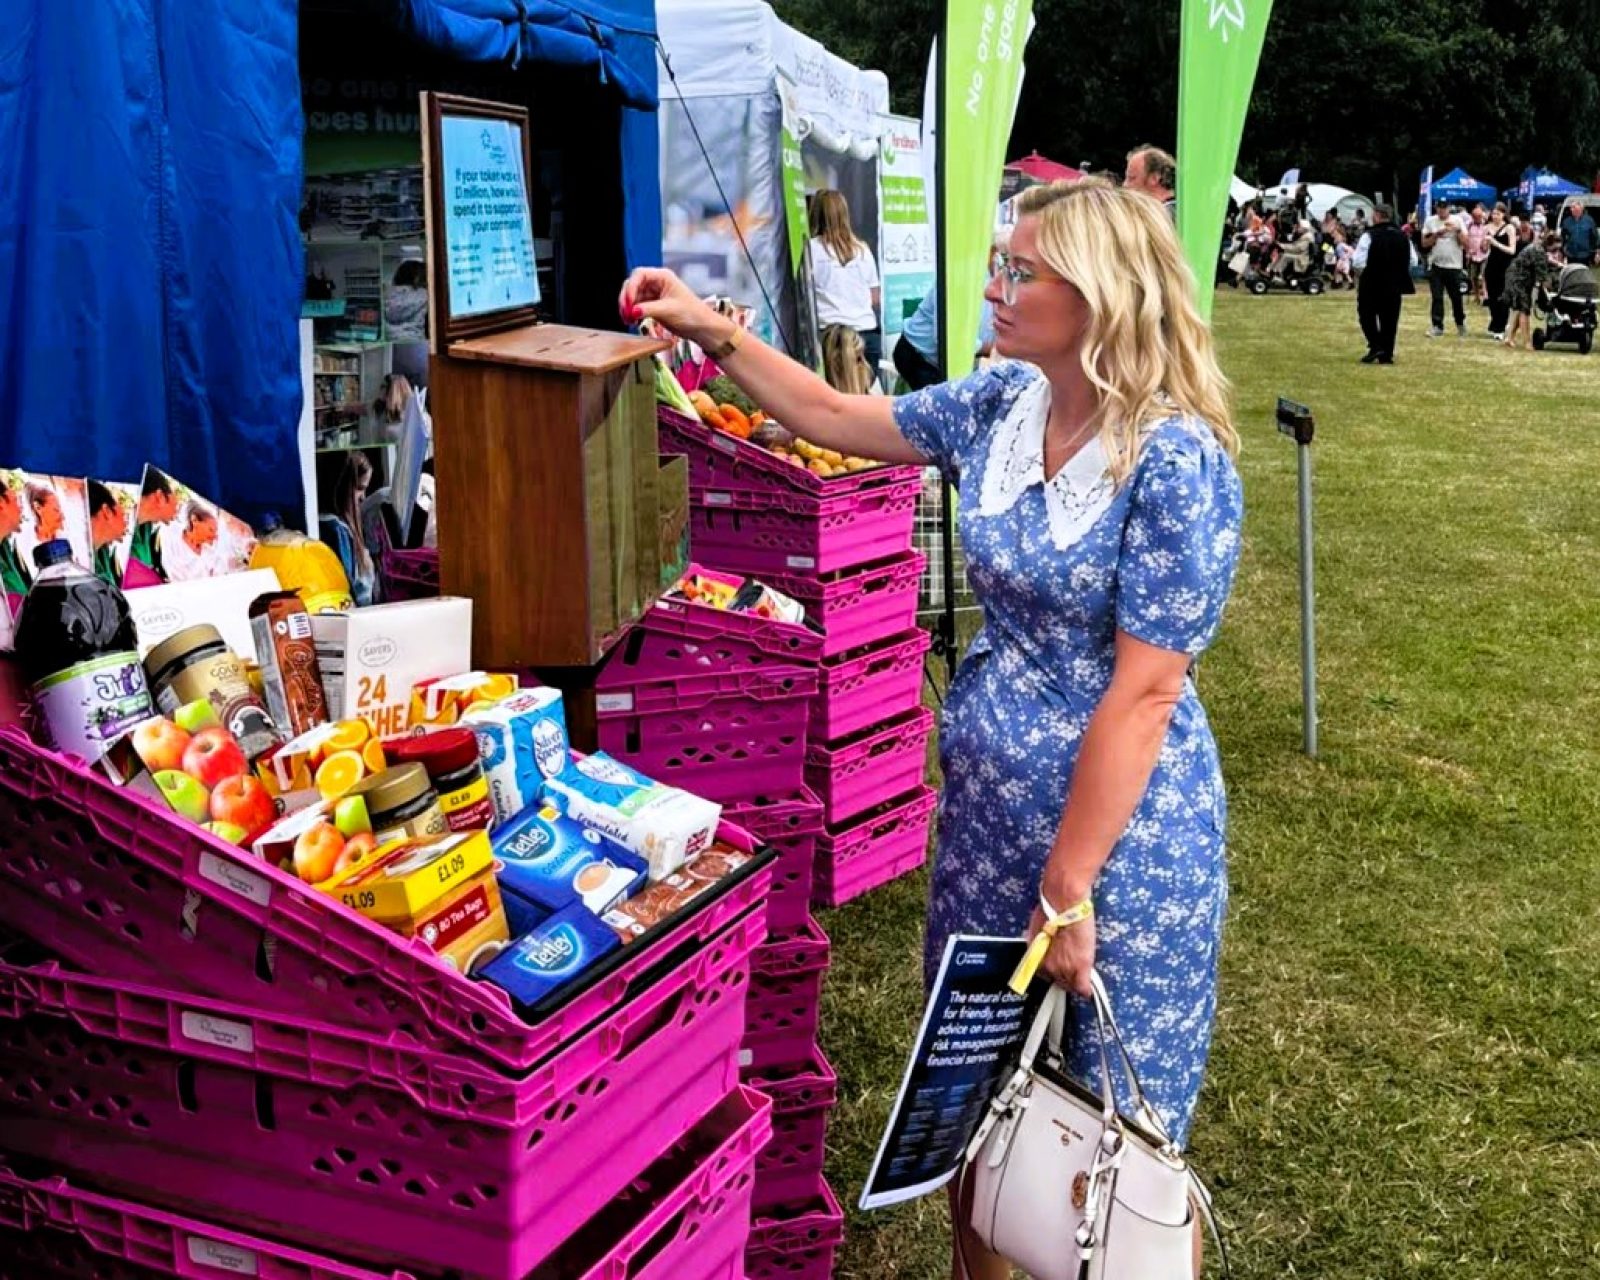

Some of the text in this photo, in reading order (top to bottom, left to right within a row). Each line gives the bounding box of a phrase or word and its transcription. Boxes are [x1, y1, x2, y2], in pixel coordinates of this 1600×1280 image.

[966, 4, 994, 116] No one
[339, 78, 399, 101] one
[303, 110, 368, 132] oes
[453, 202, 477, 218] spend
[471, 221, 490, 236] your
[358, 674, 386, 707] 24
[503, 825, 549, 858] Tetley
[438, 854, 465, 883] £1.09
[342, 891, 376, 909] £1.09
[439, 918, 451, 933] 80
[450, 910, 465, 925] Tea
[525, 931, 573, 968] Tetley
[950, 990, 967, 1004] The
[967, 990, 1002, 1004] natural
[942, 1005, 957, 1020] for
[937, 1022, 969, 1036] advice
[969, 1023, 983, 1034] on
[931, 1039, 949, 1052] risk
[950, 1035, 1007, 1053] management
[926, 1052, 966, 1067] financial
